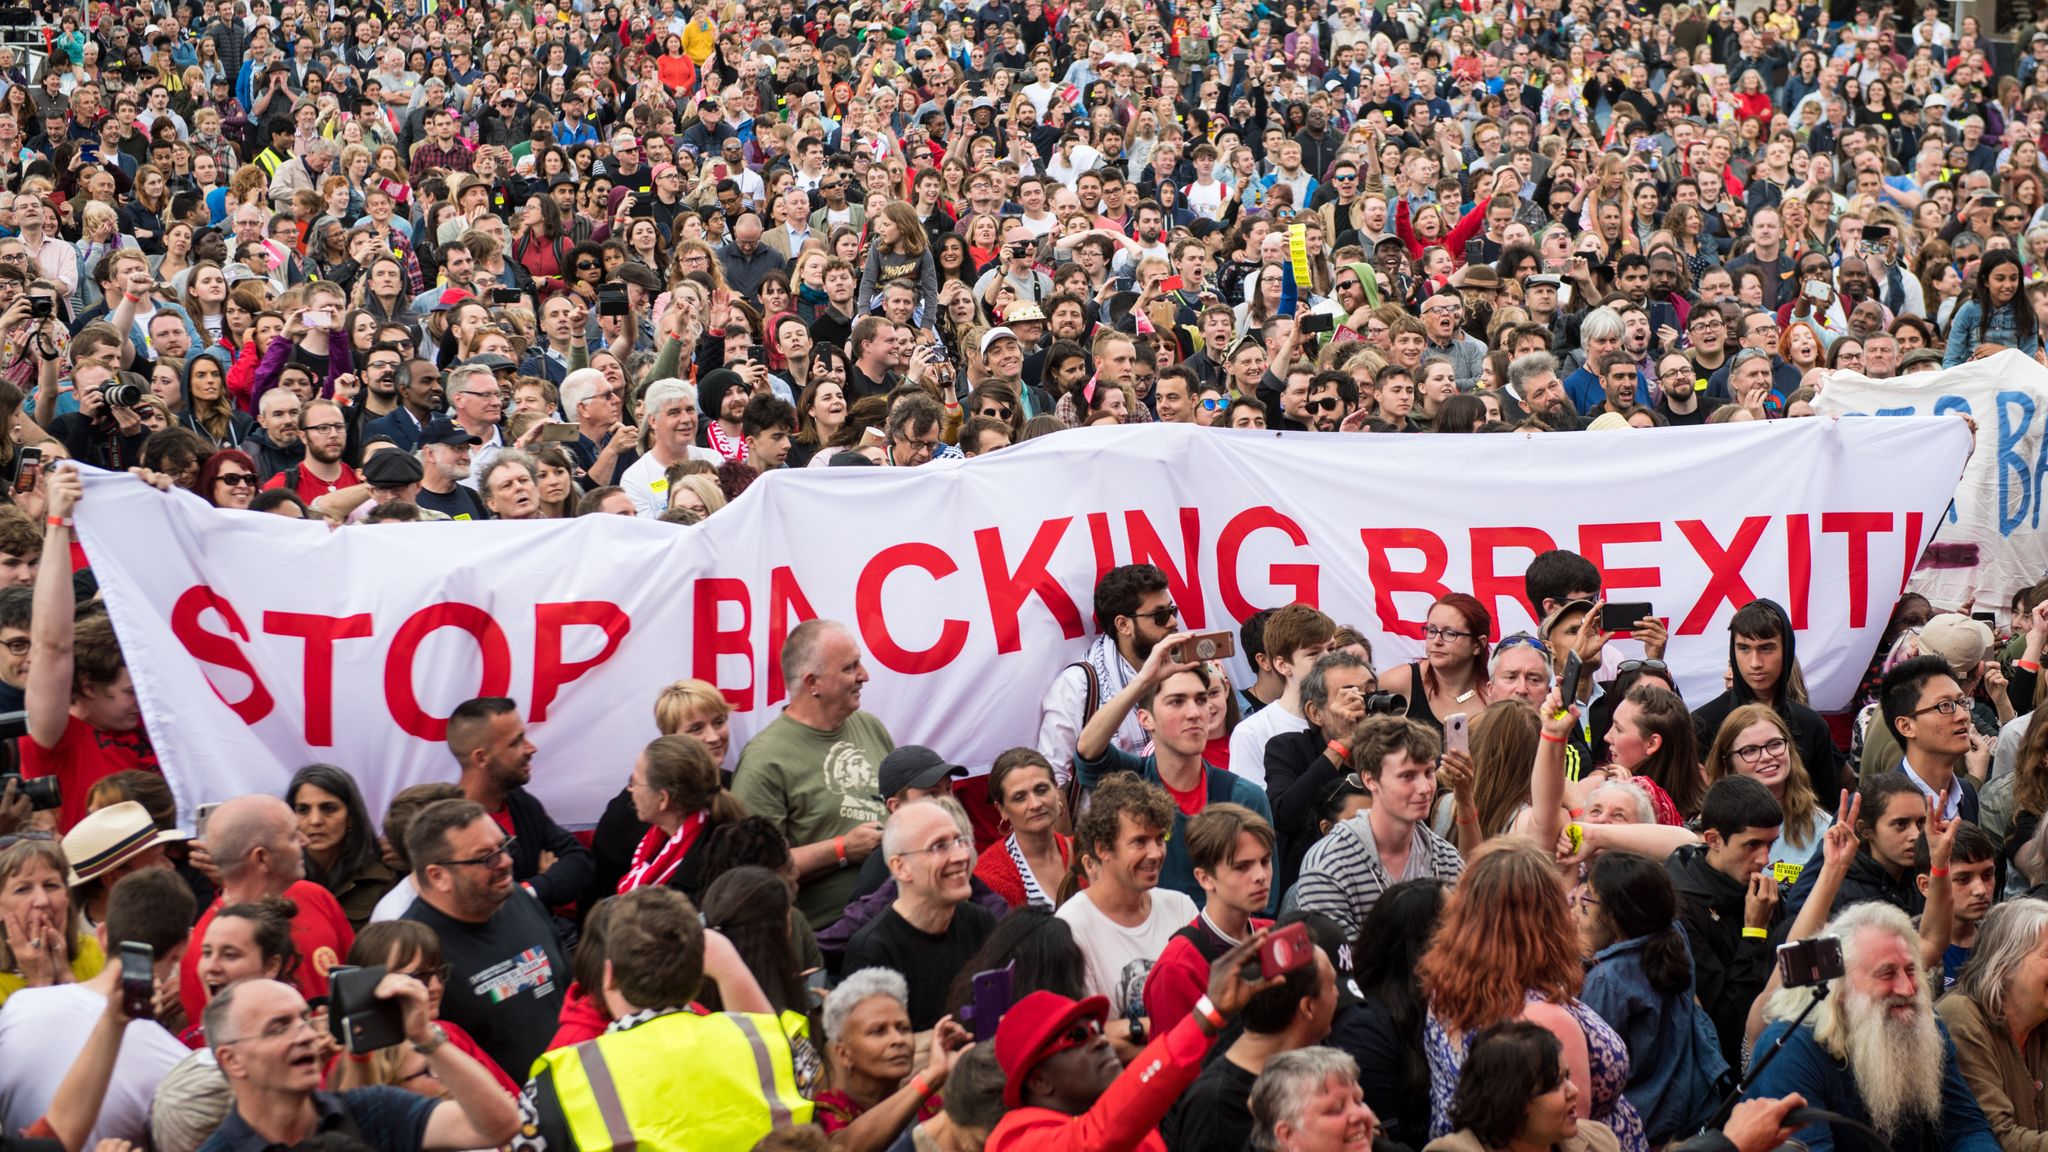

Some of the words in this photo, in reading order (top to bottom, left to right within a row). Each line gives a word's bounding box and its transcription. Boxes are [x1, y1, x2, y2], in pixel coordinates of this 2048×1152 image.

[171, 584, 631, 747] STOP
[692, 505, 1320, 713] BACKING
[839, 806, 879, 822] CORBYN
